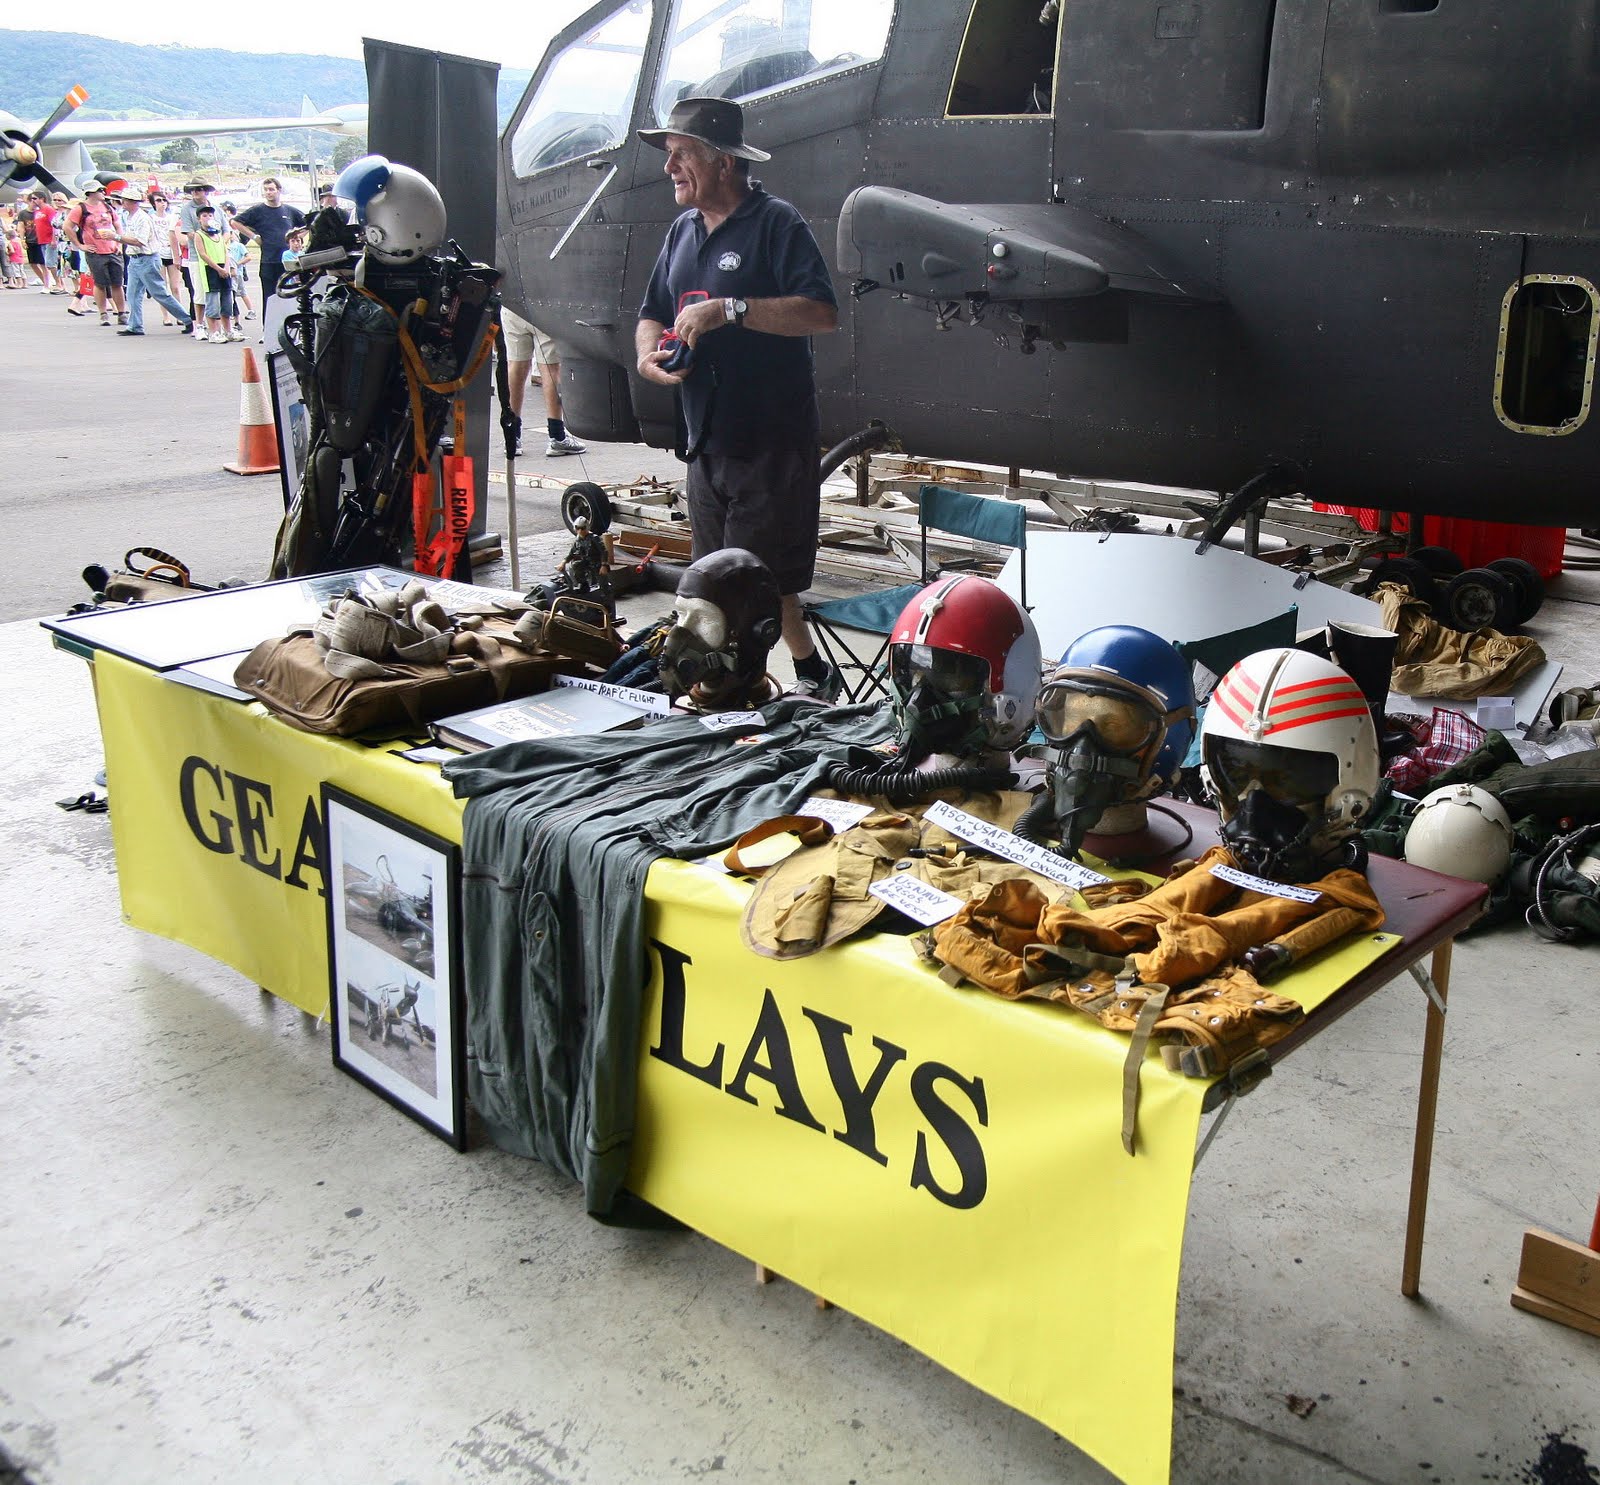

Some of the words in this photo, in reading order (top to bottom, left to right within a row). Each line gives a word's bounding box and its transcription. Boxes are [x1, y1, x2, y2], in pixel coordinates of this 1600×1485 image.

[530, 185, 569, 209] HAMILTON
[450, 487, 469, 543] REMOVE
[629, 692, 656, 705] FLIGHT
[953, 825, 975, 837] AND
[1030, 860, 1072, 883] OXYGEN
[1040, 851, 1080, 874] FLIGHT
[899, 899, 931, 917] VEST
